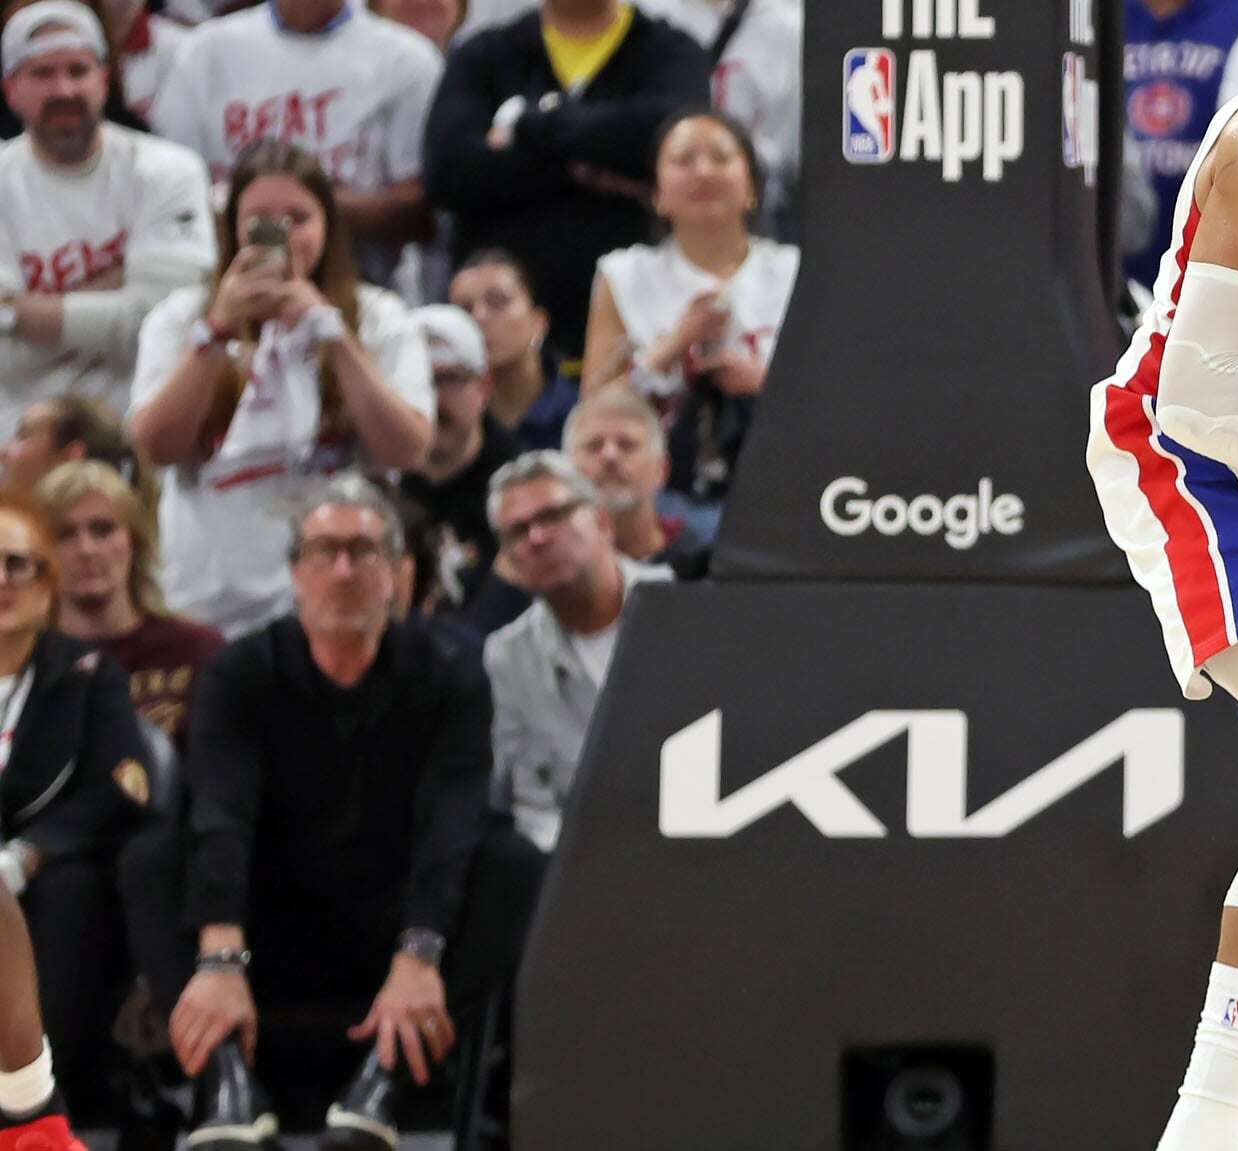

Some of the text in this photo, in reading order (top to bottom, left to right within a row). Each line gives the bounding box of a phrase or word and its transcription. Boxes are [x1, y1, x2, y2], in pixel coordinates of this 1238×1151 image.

[899, 49, 1024, 182] App
[819, 475, 1025, 549] Google
[658, 707, 1186, 839] KIA
